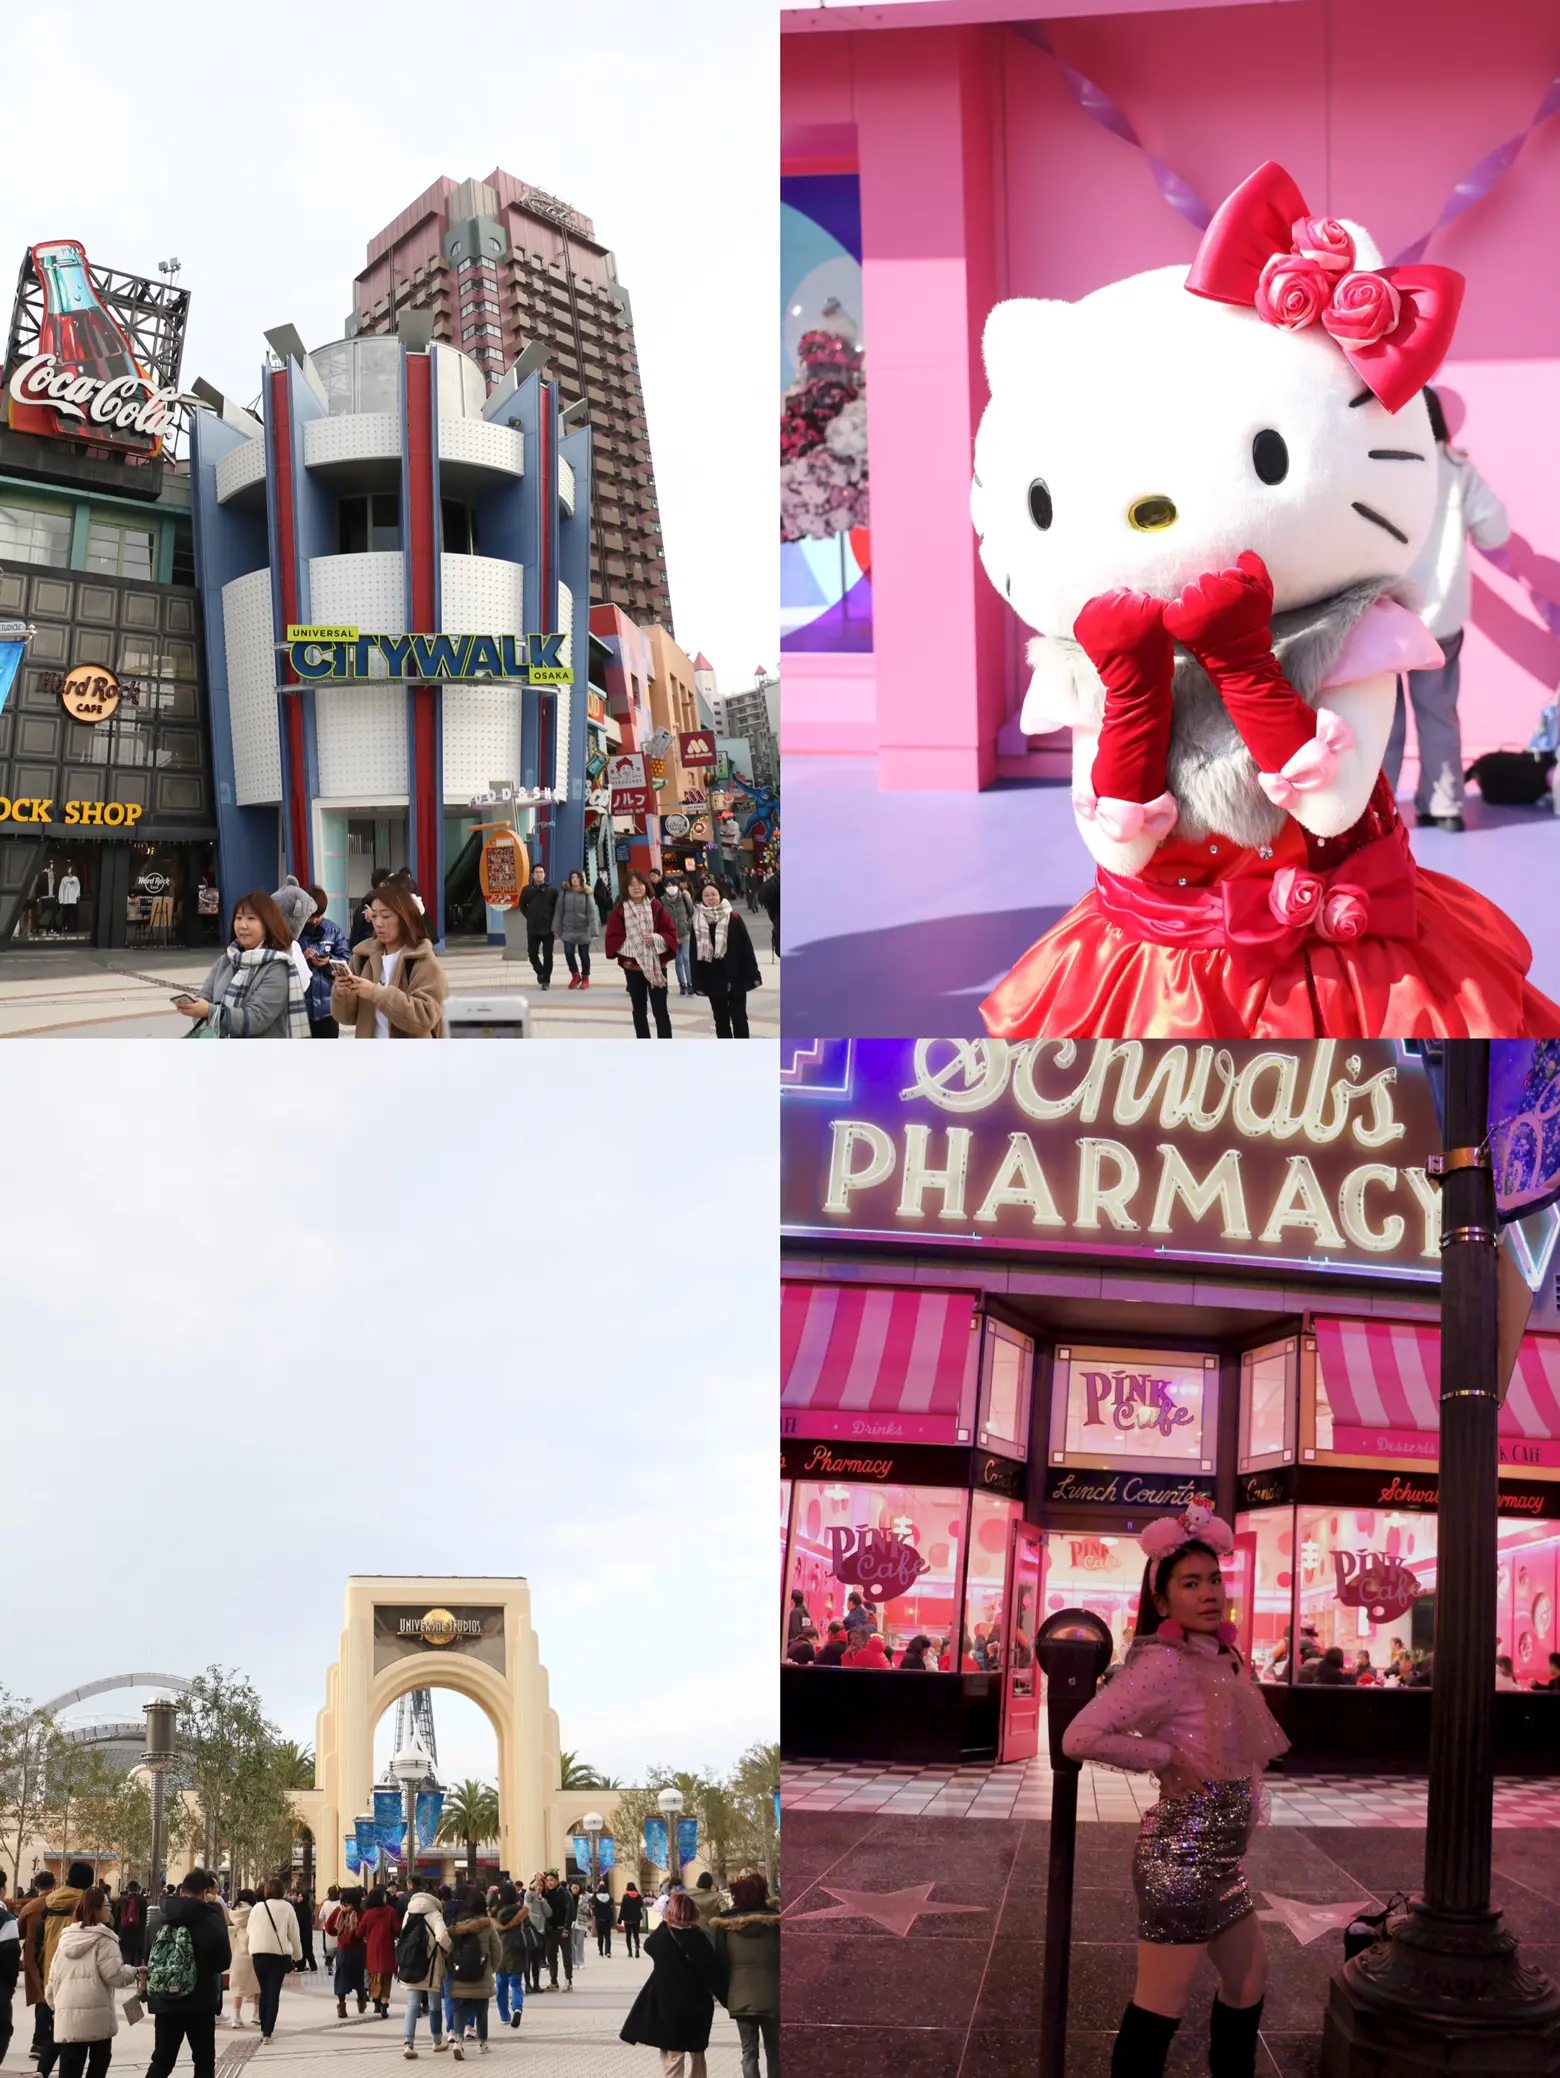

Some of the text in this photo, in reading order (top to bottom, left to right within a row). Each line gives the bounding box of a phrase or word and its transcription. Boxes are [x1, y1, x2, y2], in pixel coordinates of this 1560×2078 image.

[9, 353, 182, 436] Coca-Cola
[291, 628, 354, 638] UNIVERSAL
[290, 633, 568, 680] CITYWALK
[35, 671, 141, 706] Hard Rock
[533, 670, 570, 681] OSAKA
[76, 703, 103, 714] CAFE
[0, 796, 143, 826] OCK SHOP
[900, 1040, 1406, 1148] Schwab's
[822, 1120, 1442, 1258] PHARMACY
[852, 1420, 904, 1436] Drinks
[1376, 1437, 1436, 1455] Desserts
[1512, 1444, 1542, 1463] CAFE
[804, 1445, 893, 1479] Pharmacy
[1052, 1474, 1118, 1501] Lunch
[1378, 1477, 1438, 1503] Schwa
[1497, 1493, 1545, 1514] rmacy
[857, 1550, 931, 1585] Cafe
[1360, 1575, 1426, 1607] Cafe
[400, 1618, 481, 1633] UNIVERSAL STUDIOS
